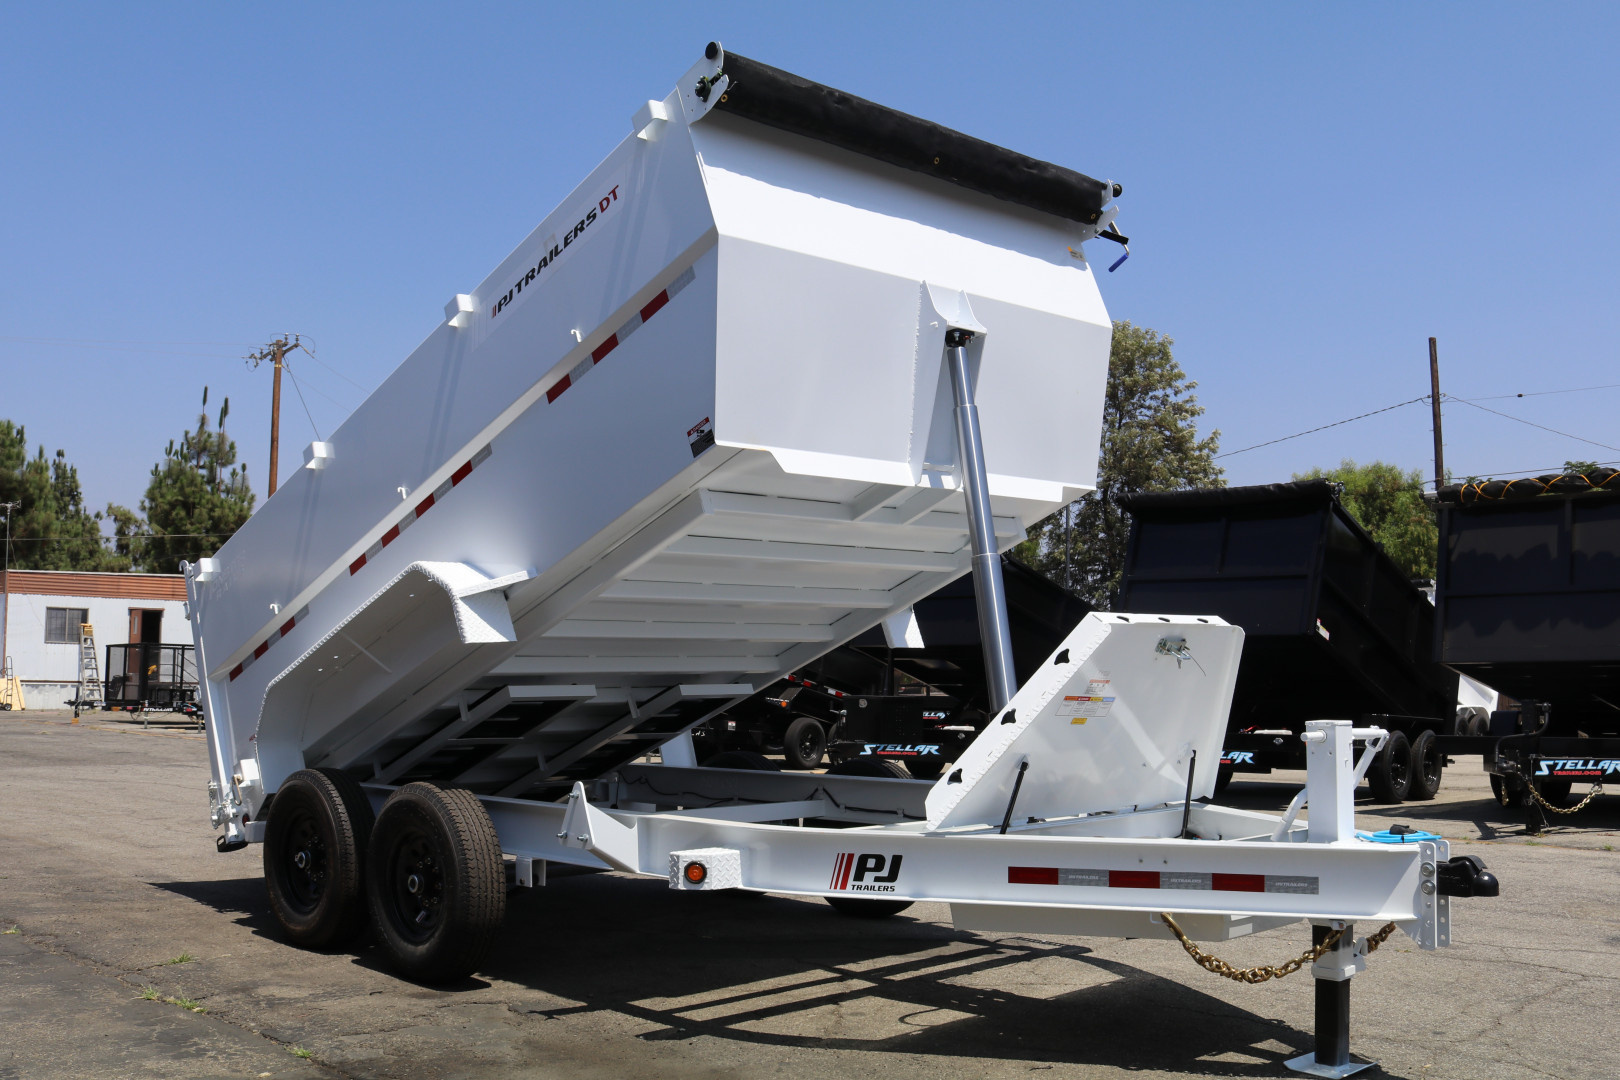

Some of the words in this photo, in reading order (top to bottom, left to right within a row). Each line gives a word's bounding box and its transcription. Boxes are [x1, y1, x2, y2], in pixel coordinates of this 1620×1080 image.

[497, 288, 514, 314] PJ
[514, 207, 597, 295] TRAILERS
[598, 184, 620, 214] DT
[859, 743, 941, 756] STELLAR
[1535, 759, 1620, 776] STELLAR
[853, 853, 903, 883] PJ
[851, 884, 896, 892] TRAILERS
